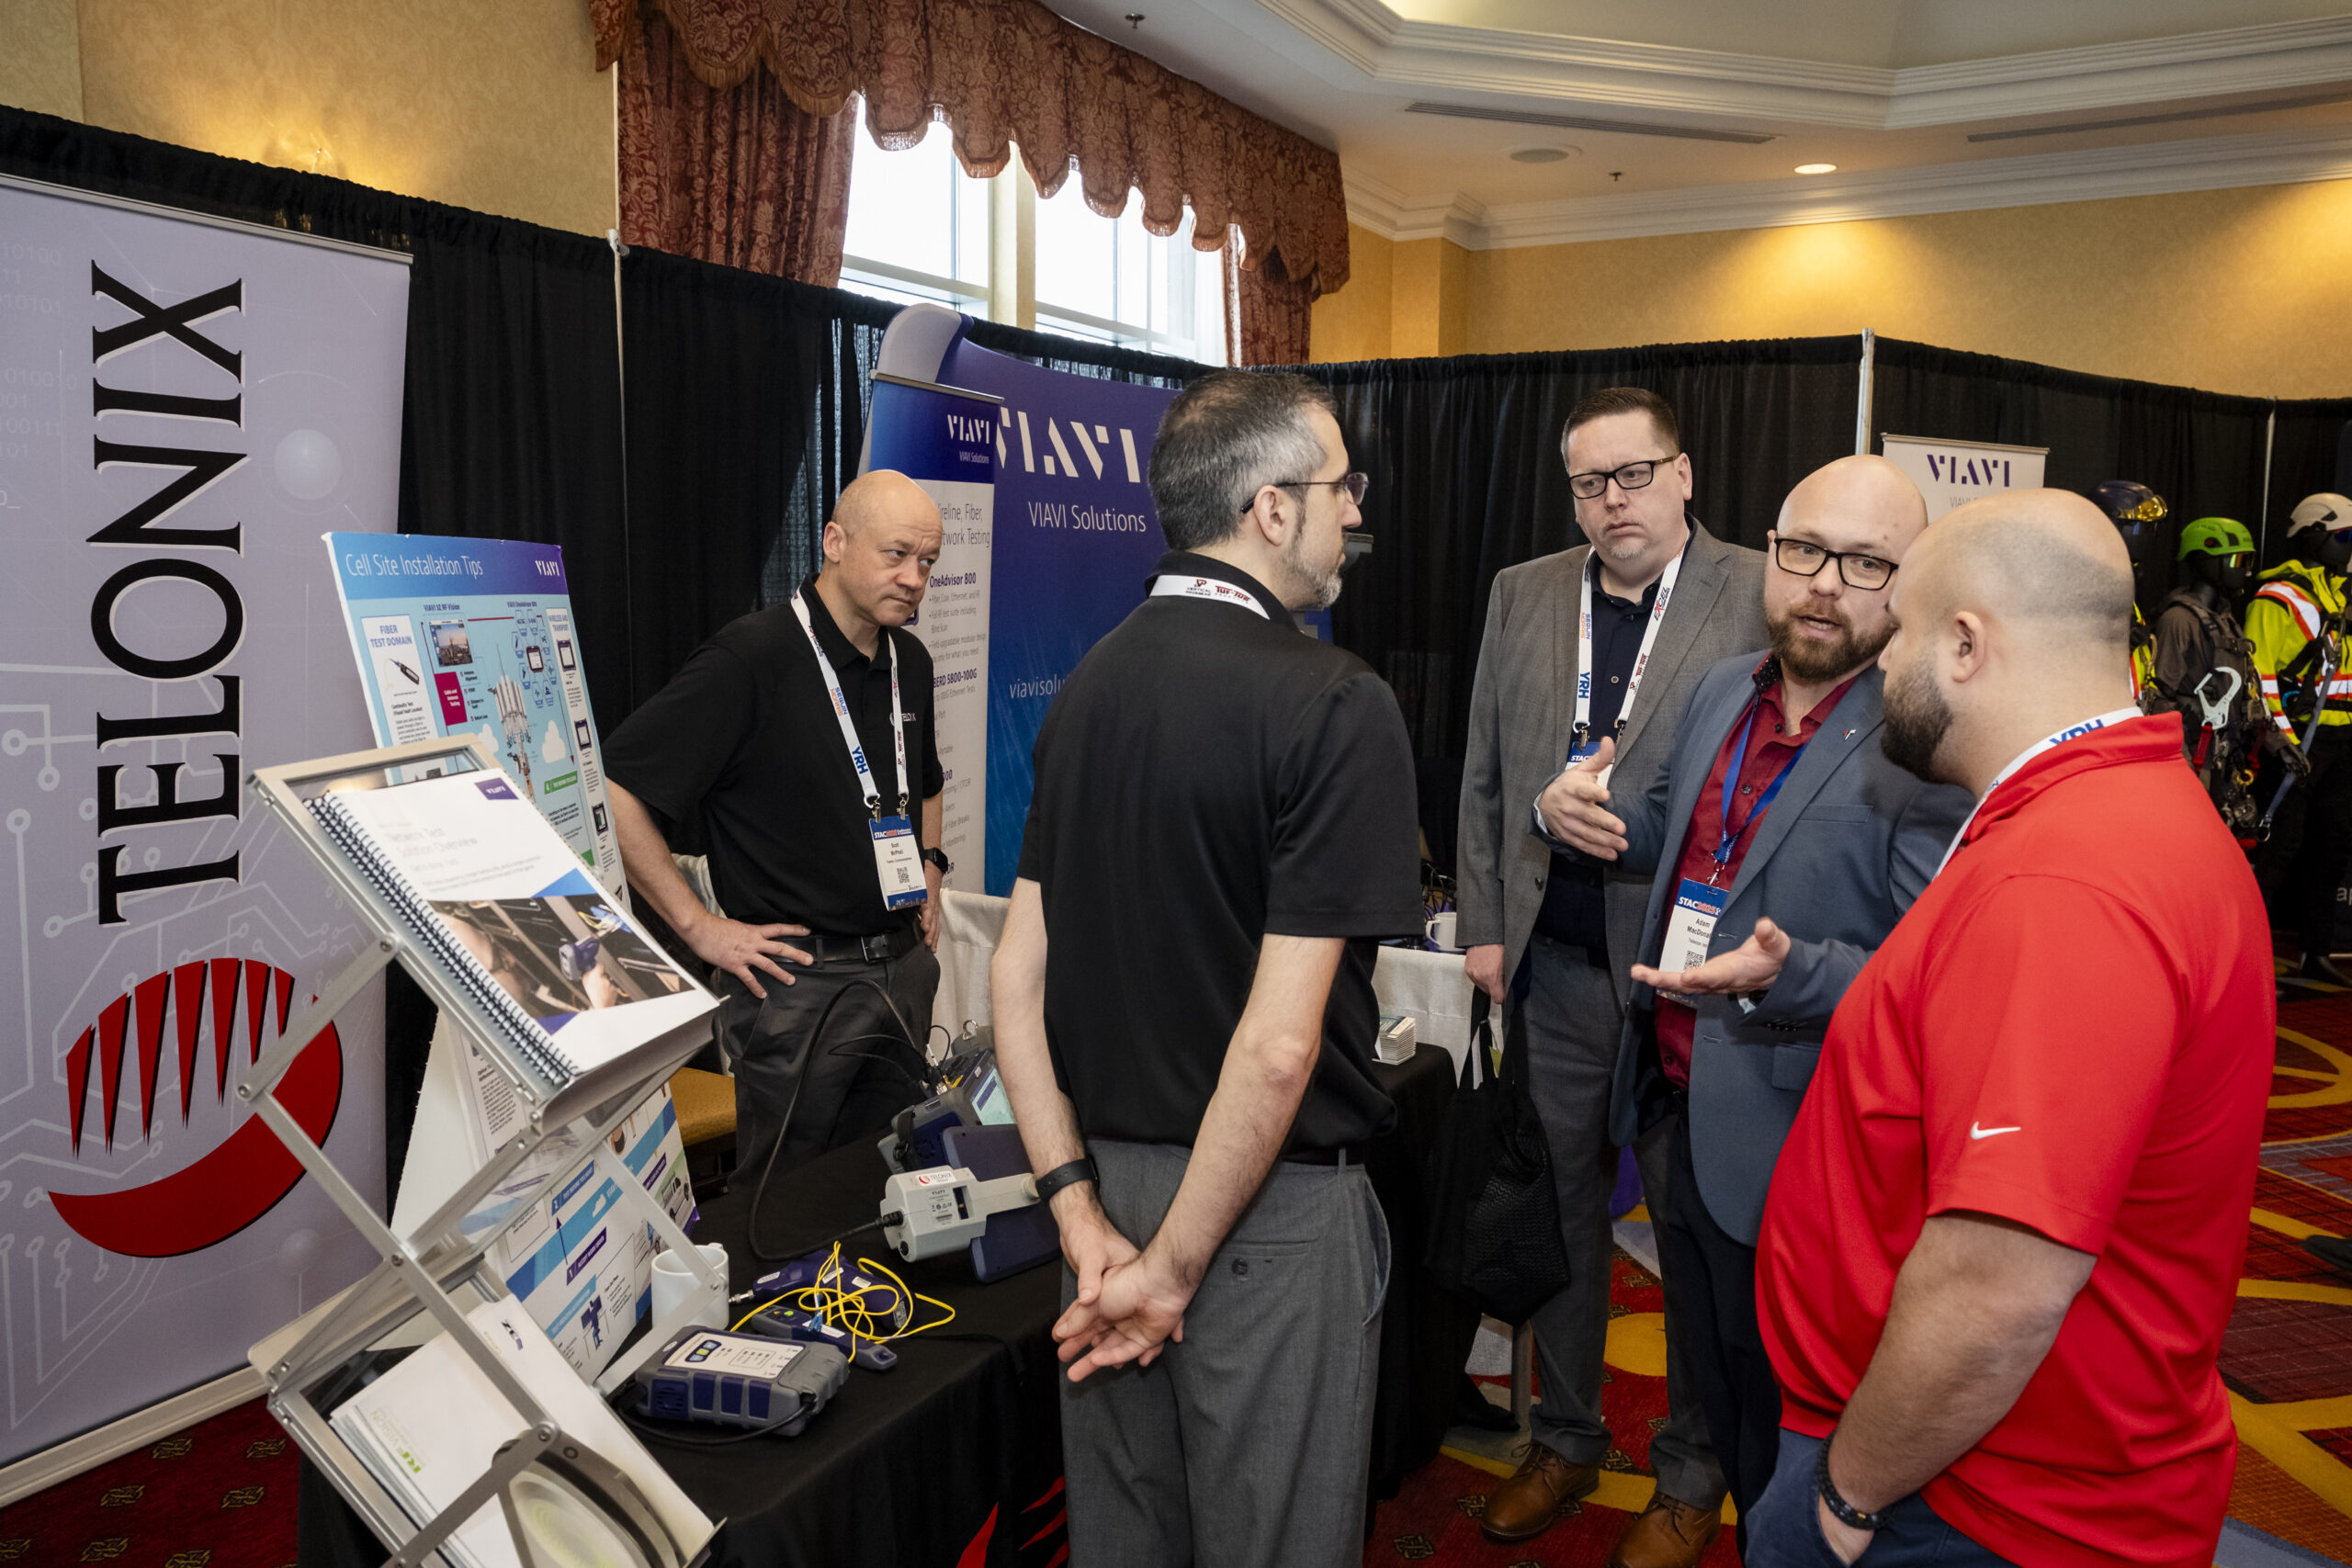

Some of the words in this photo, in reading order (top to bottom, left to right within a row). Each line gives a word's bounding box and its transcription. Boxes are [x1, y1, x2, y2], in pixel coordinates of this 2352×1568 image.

[947, 414, 990, 445] VIAVI
[996, 406, 1141, 483] VIAVI
[959, 451, 970, 463] VIAVI
[971, 452, 989, 464] Solutions
[1927, 454, 2010, 488] VIAVI
[939, 504, 963, 523] ireline,
[965, 504, 983, 522] Fiber,
[1028, 501, 1067, 529] VIAVI
[1071, 504, 1147, 533] Solutions
[943, 529, 965, 546] twork
[967, 529, 990, 548] Testing
[345, 553, 371, 577] Cell
[373, 554, 400, 576] Site
[401, 554, 462, 576] Installation
[460, 555, 484, 580] Tips
[535, 559, 560, 578] VIAVI
[929, 574, 964, 589] OneAdvisor
[964, 572, 977, 585] 800
[85, 260, 249, 925] TELONIX
[379, 625, 398, 635] FIBER
[370, 637, 386, 648] TEST
[387, 636, 413, 647] DOMAIN
[933, 675, 946, 688] BERD
[947, 669, 978, 684] 5800-100G
[1577, 671, 1590, 699] YRH
[851, 746, 868, 775] YRH
[1696, 918, 1710, 928] Adam
